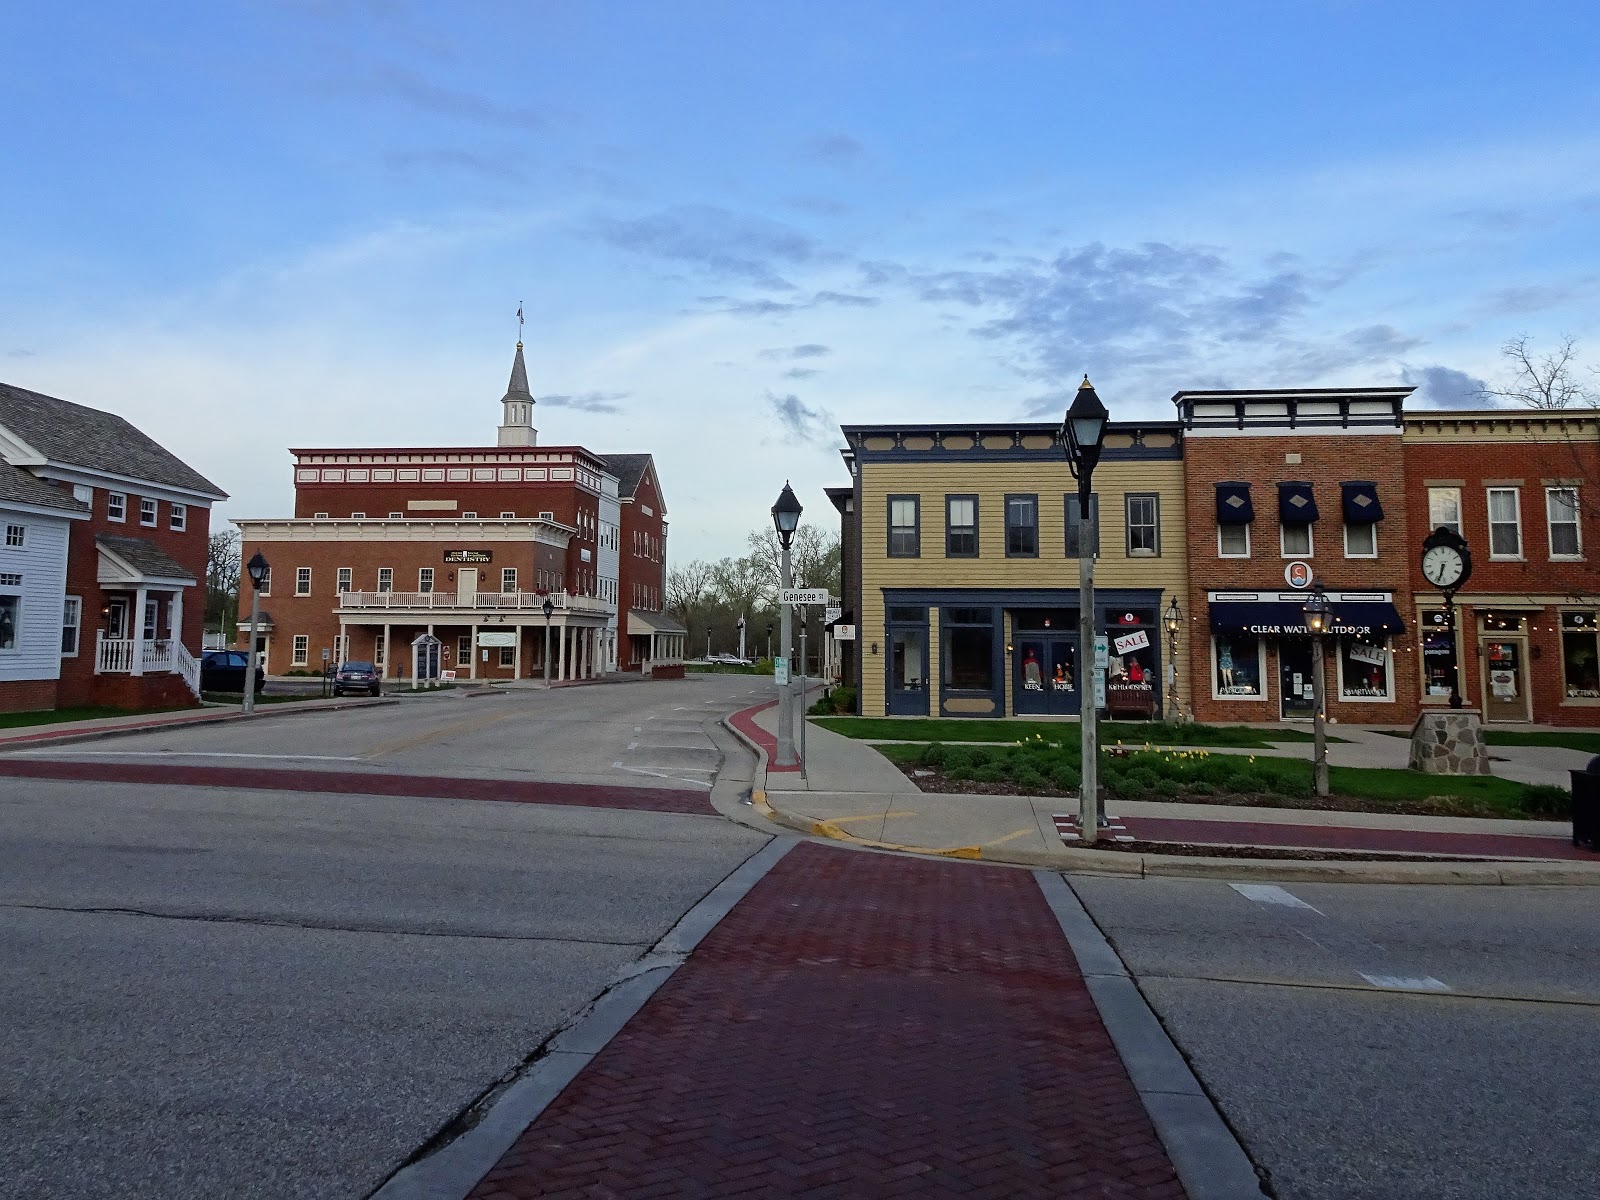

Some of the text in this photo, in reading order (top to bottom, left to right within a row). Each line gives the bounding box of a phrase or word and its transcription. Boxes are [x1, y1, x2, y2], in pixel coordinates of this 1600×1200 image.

[783, 591, 816, 602] Genesee
[1250, 625, 1281, 634] CLEAR
[1116, 634, 1147, 651] SALE
[1351, 645, 1384, 661] SALE
